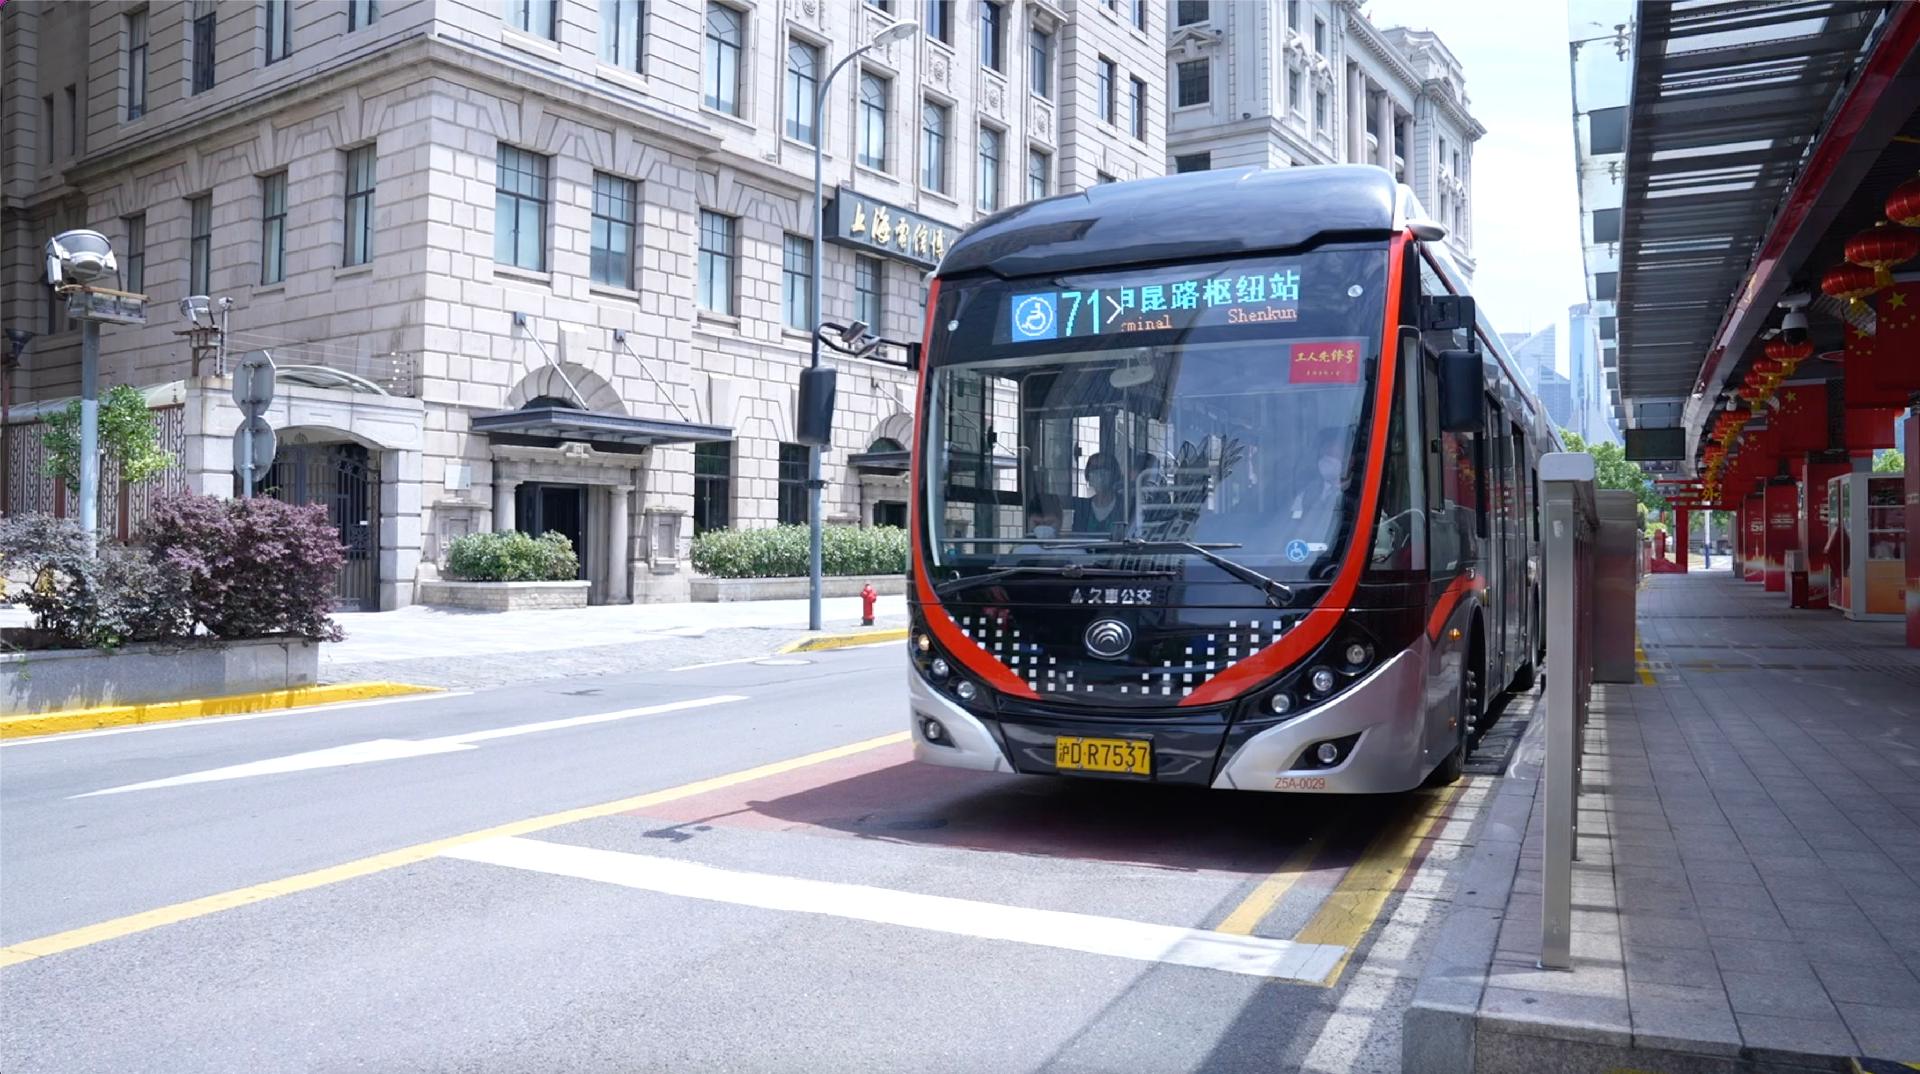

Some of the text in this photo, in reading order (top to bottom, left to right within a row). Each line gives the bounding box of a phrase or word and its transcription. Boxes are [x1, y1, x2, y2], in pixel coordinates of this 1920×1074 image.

[1062, 289, 1099, 336] 71
[1228, 305, 1297, 324] Shenkun
[1274, 777, 1326, 790] Z5A-0029
